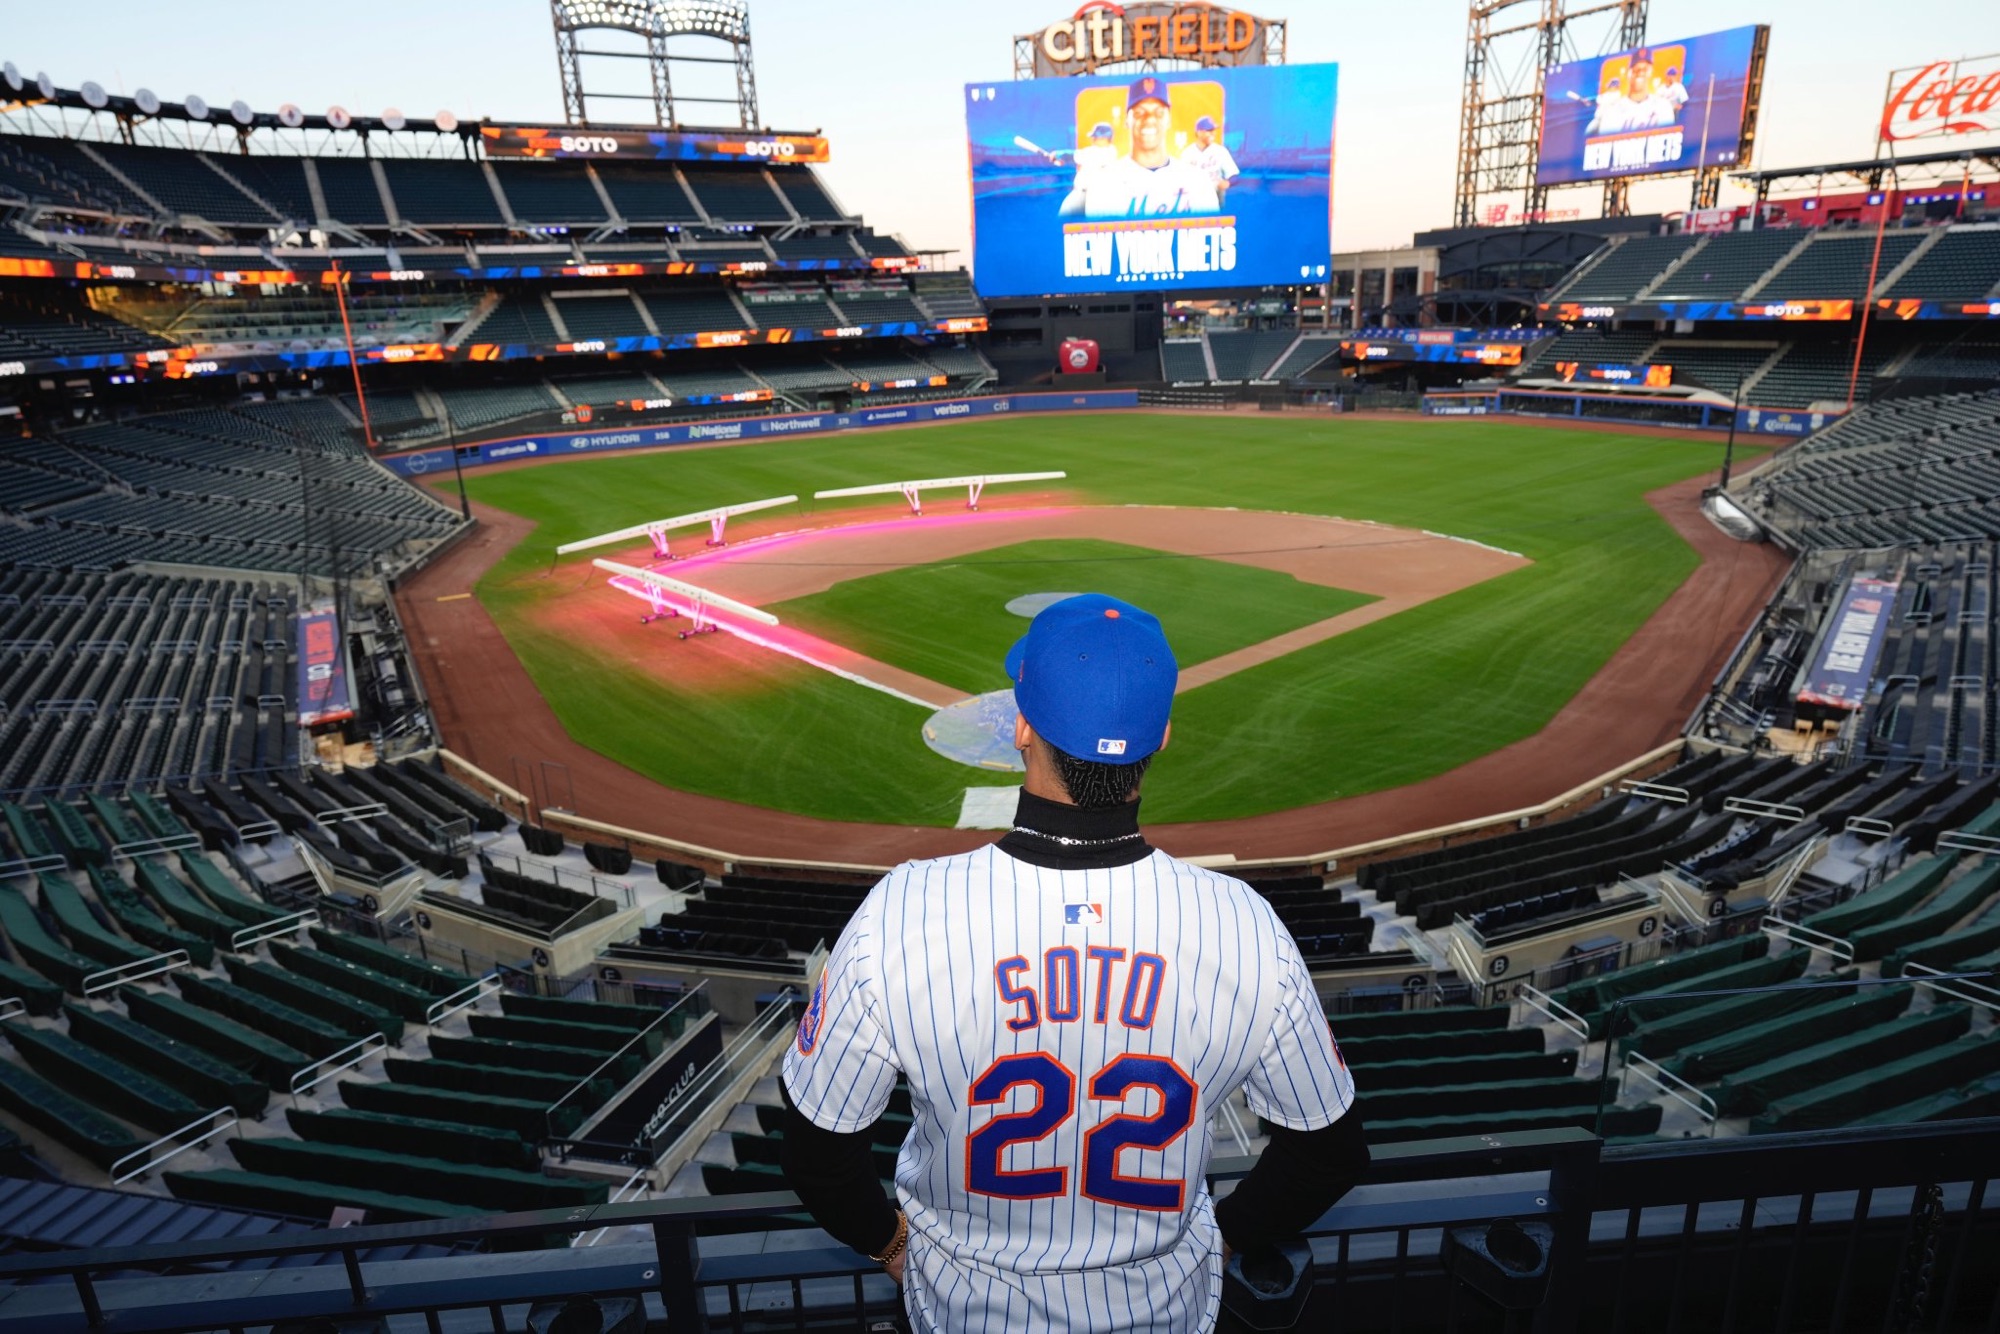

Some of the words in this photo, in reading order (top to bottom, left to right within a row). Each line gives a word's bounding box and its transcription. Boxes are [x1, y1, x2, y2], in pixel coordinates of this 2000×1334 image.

[1044, 10, 1123, 62] citi
[1134, 12, 1255, 56] FIELD
[561, 137, 617, 153] SOTO
[745, 140, 794, 156] SOTO
[1646, 132, 1683, 163] METS
[1064, 232, 1114, 277] NEW
[1115, 229, 1175, 274] YORK
[1177, 226, 1236, 272] METS
[578, 265, 608, 276] SOTO
[740, 261, 767, 272] SOTO
[390, 270, 424, 281] SOTO
[1583, 306, 1615, 317] SOTO
[1765, 305, 1805, 316] SOTO
[948, 321, 973, 330] SOTO
[836, 327, 863, 337] SOTO
[712, 334, 742, 344] SOTO
[573, 341, 606, 352] SOTO
[383, 347, 414, 358] SOTO
[1476, 349, 1501, 359] SOTO
[1603, 369, 1631, 379] SOTO
[895, 379, 917, 388] SOTO
[733, 392, 757, 401] SOTO
[645, 399, 672, 409] SOTO
[933, 403, 970, 416] verizon
[993, 400, 1010, 412] citi
[770, 417, 820, 431] Northwell
[1764, 419, 1803, 432] Corona
[701, 423, 741, 437] National
[591, 433, 641, 446] HYUNDAI
[1643, 919, 1653, 933] B
[1494, 960, 1505, 972] B
[993, 944, 1167, 1033] SOTO
[964, 1051, 1199, 1212] 22
